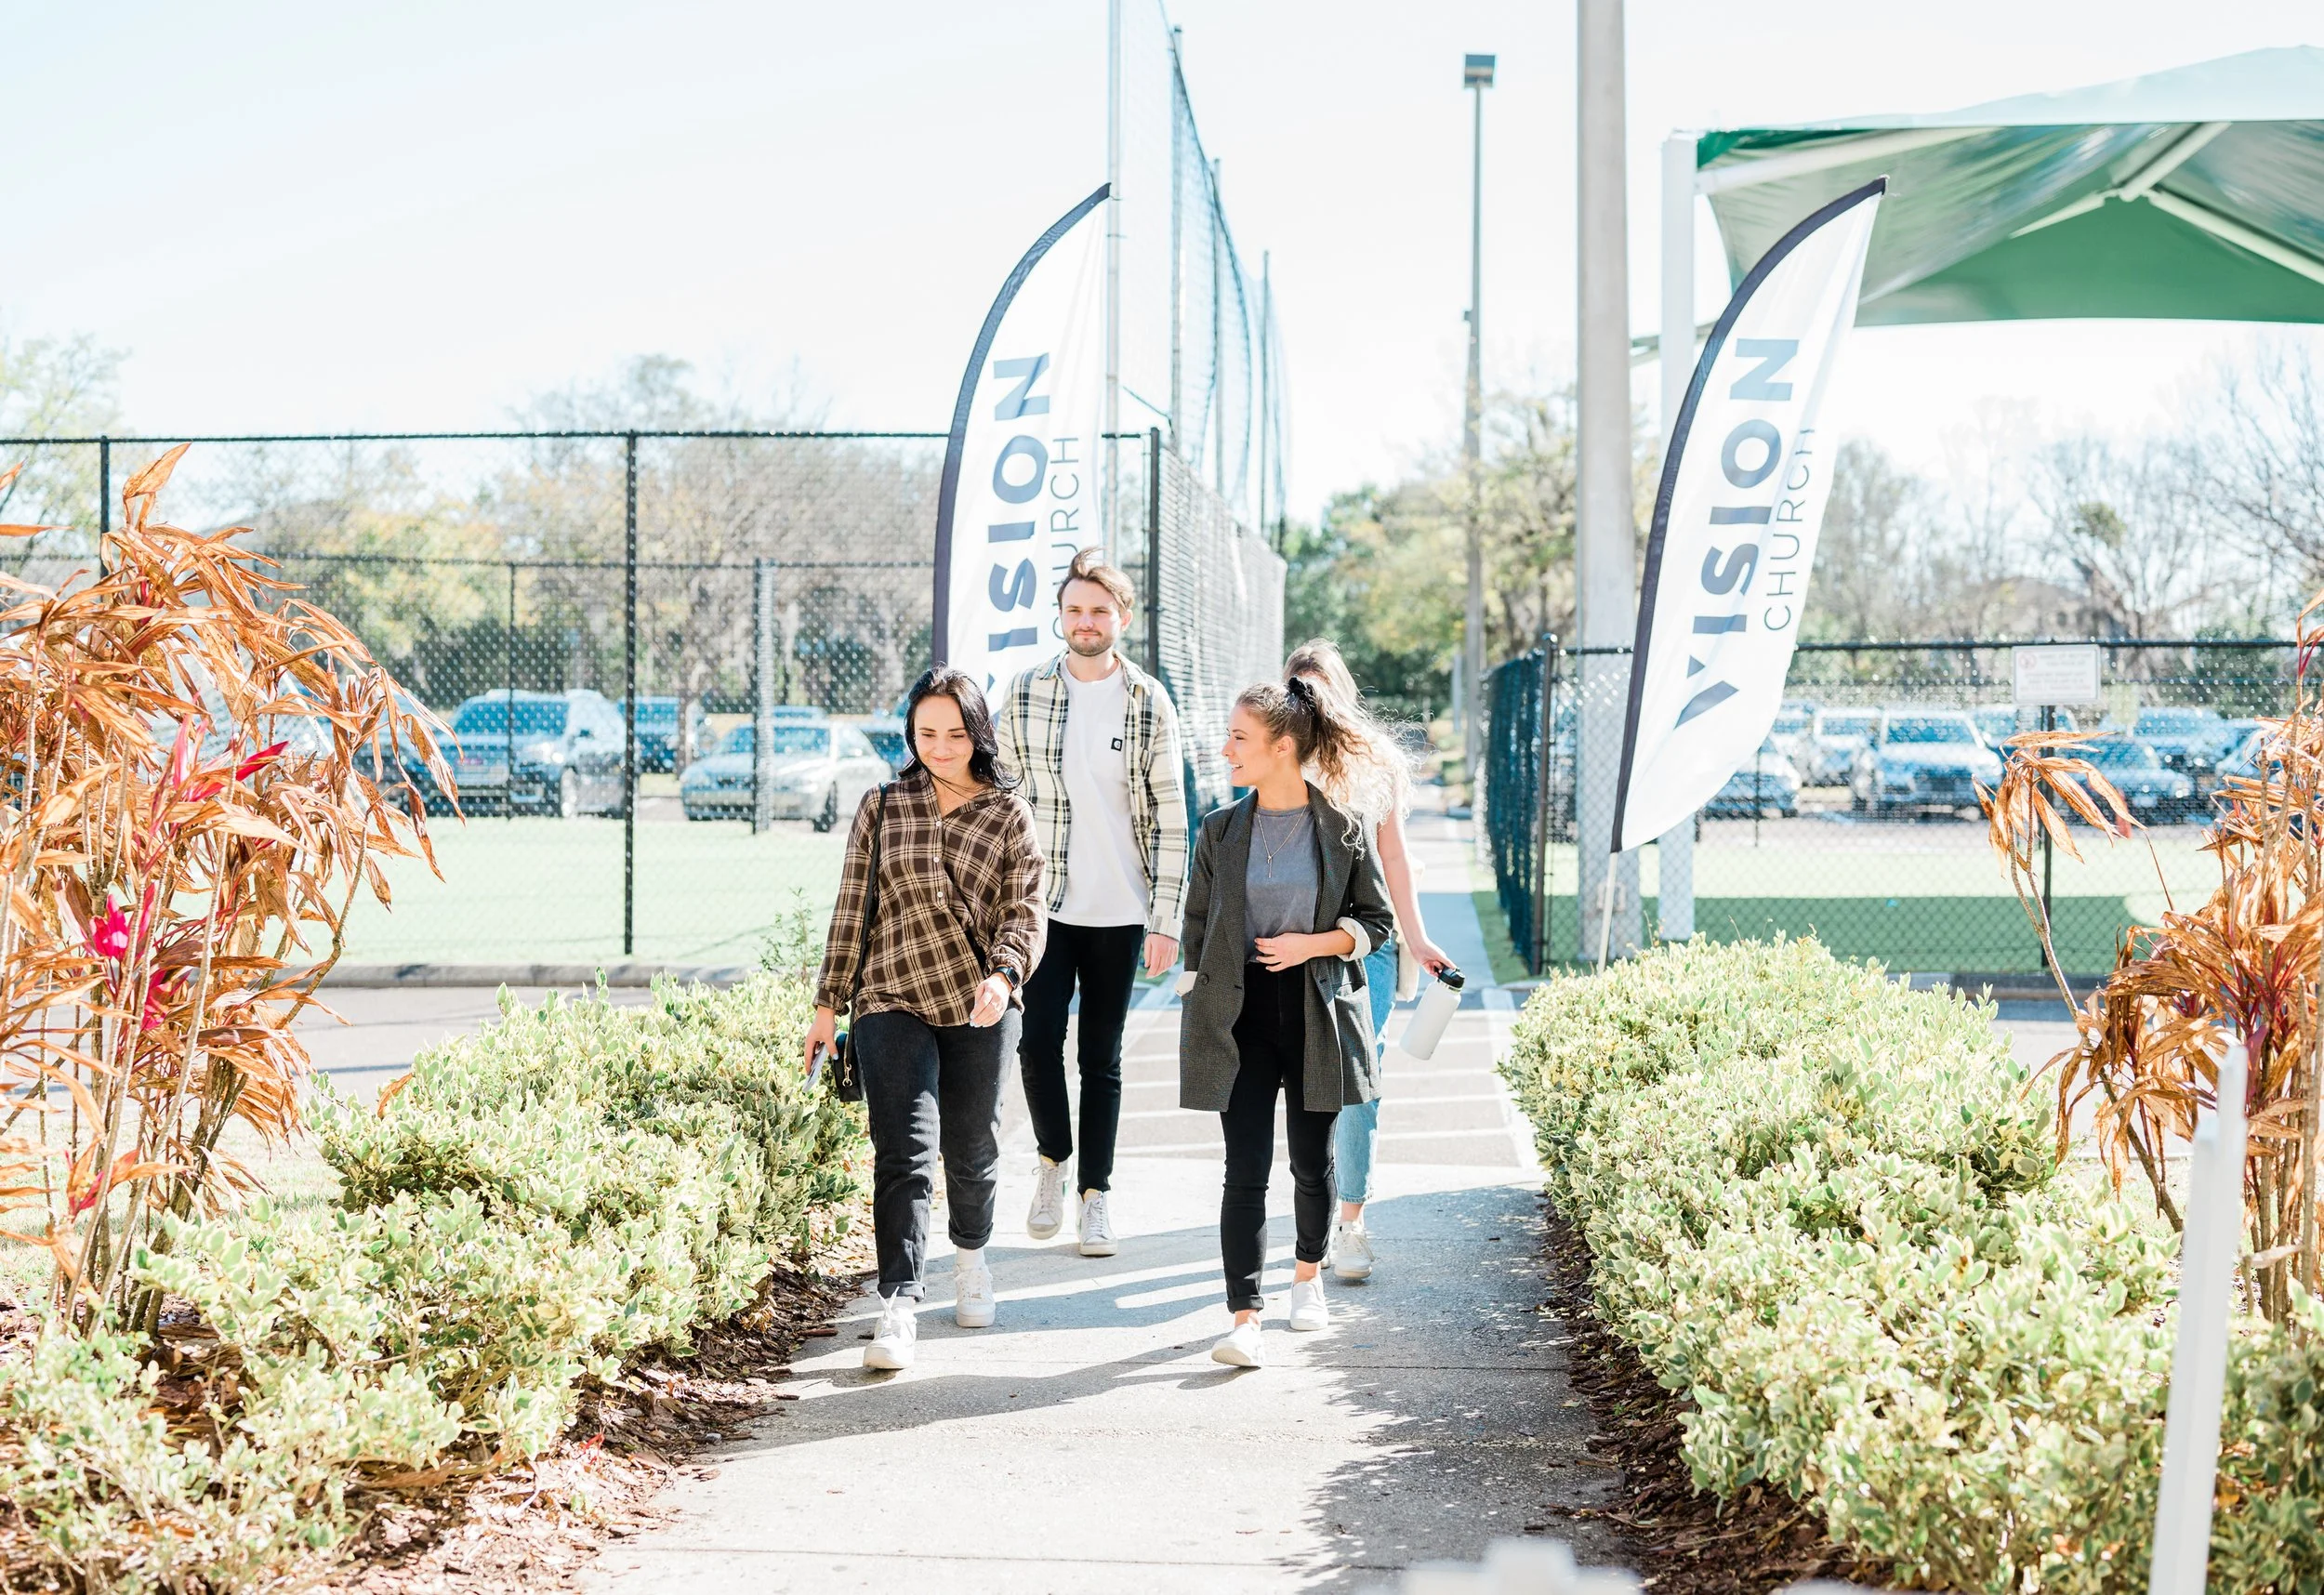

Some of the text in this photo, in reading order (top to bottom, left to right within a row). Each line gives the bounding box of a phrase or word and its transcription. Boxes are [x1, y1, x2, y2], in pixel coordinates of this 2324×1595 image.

[986, 352, 1050, 730] ISION
[1673, 337, 1799, 730] VISION
[1764, 428, 1816, 631] CHURCH
